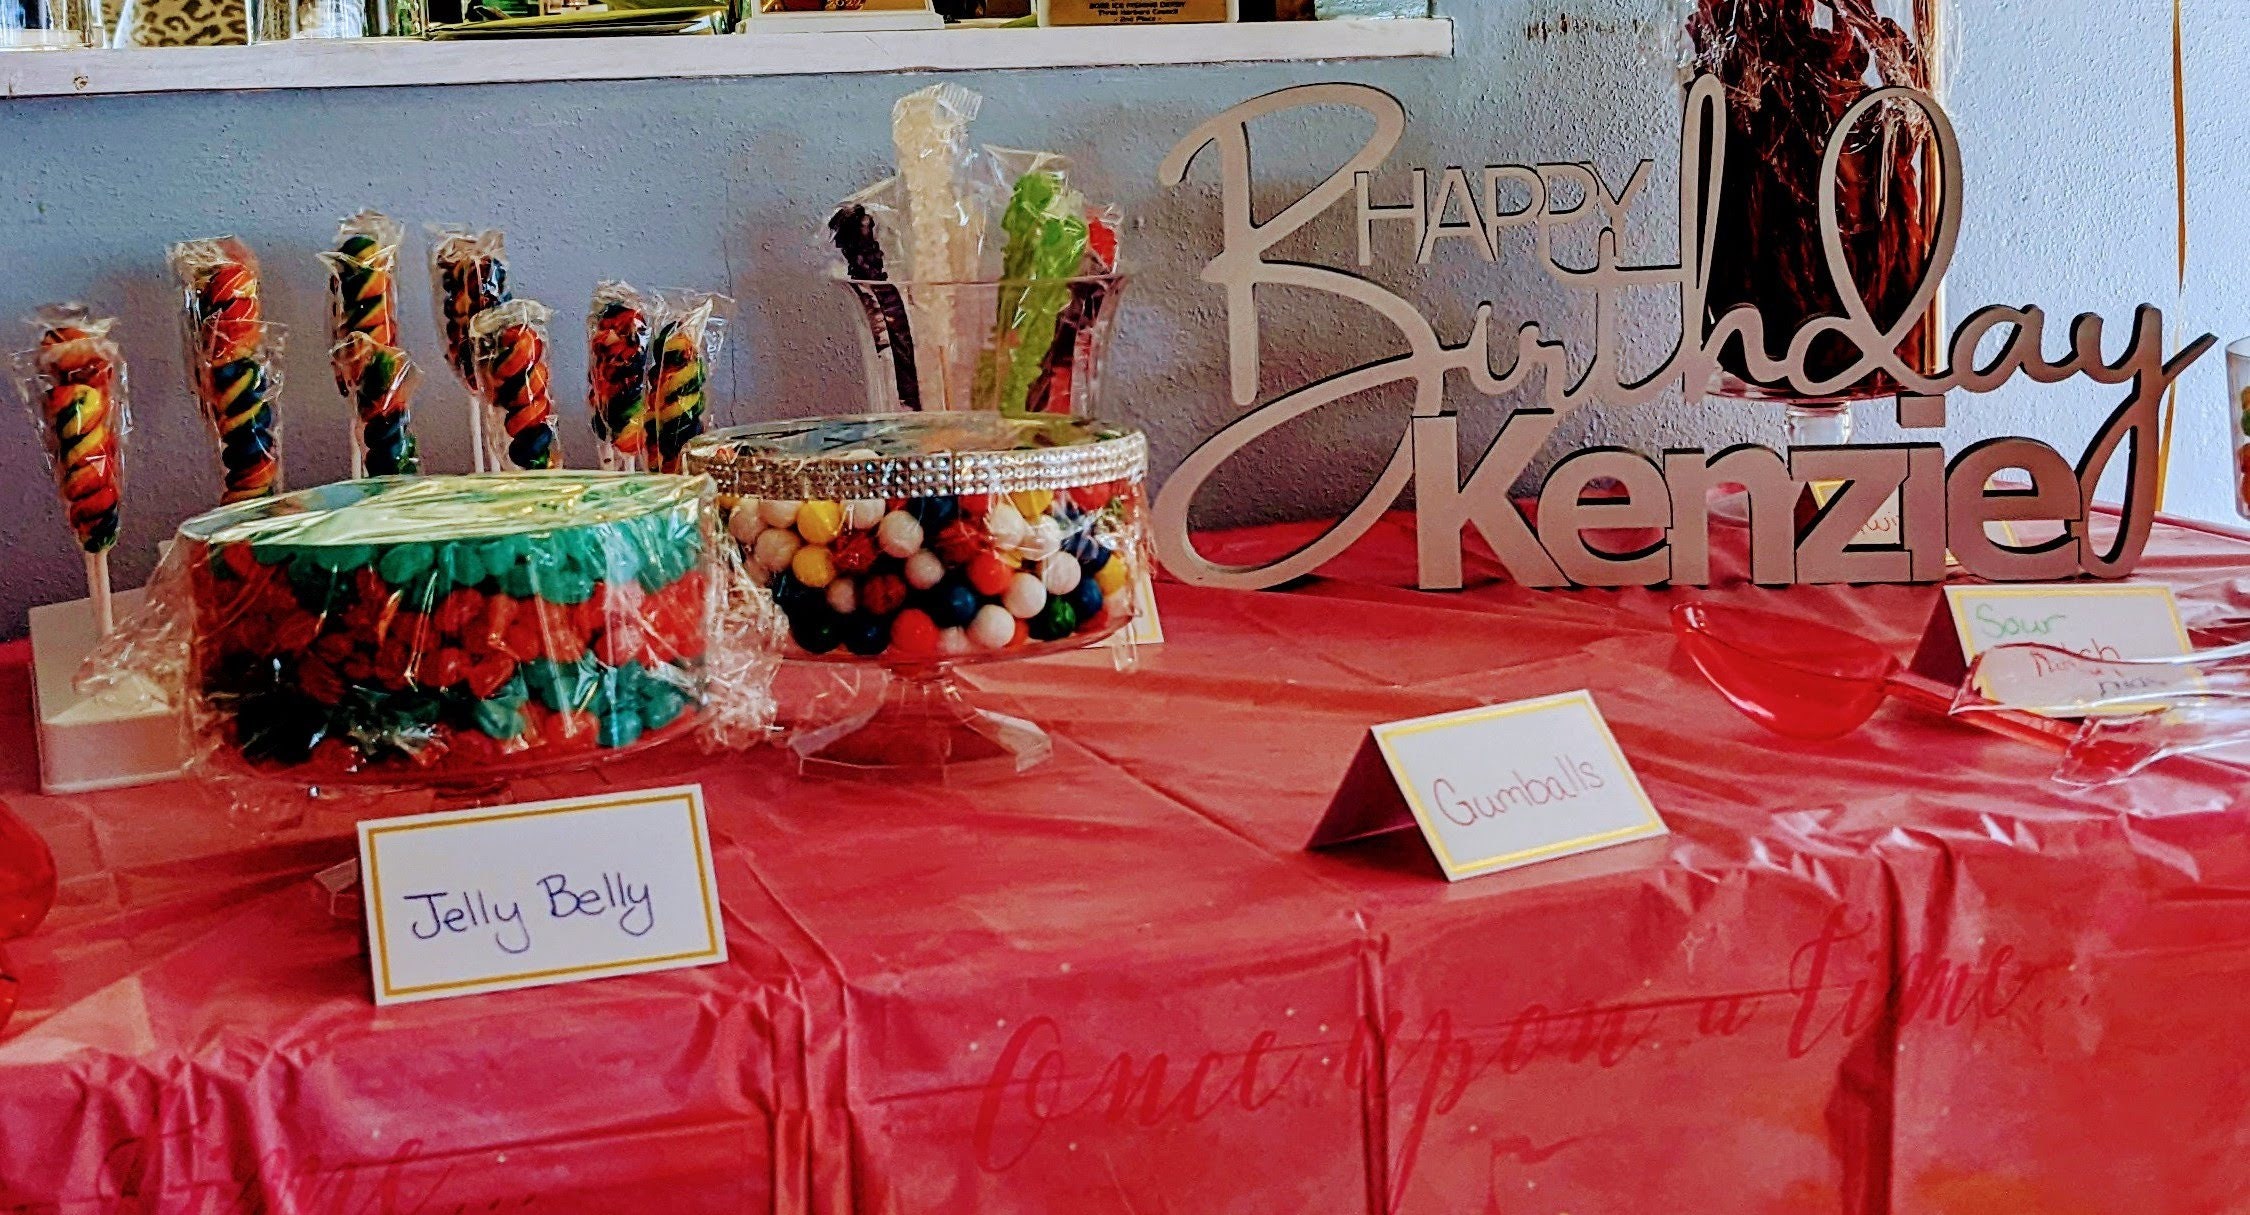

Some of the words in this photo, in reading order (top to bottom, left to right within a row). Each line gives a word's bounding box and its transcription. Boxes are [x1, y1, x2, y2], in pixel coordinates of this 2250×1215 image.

[1353, 157, 1651, 265] HAPPY
[1157, 73, 2218, 590] Birthday
[1412, 394, 2082, 591] Kenzie
[1976, 602, 2066, 639] Sour
[1433, 754, 1605, 827] Gumballs
[403, 889, 531, 954] Jelly
[536, 872, 655, 937] Belly
[972, 1016, 1302, 1173] Once
[1697, 996, 1762, 1036] a
